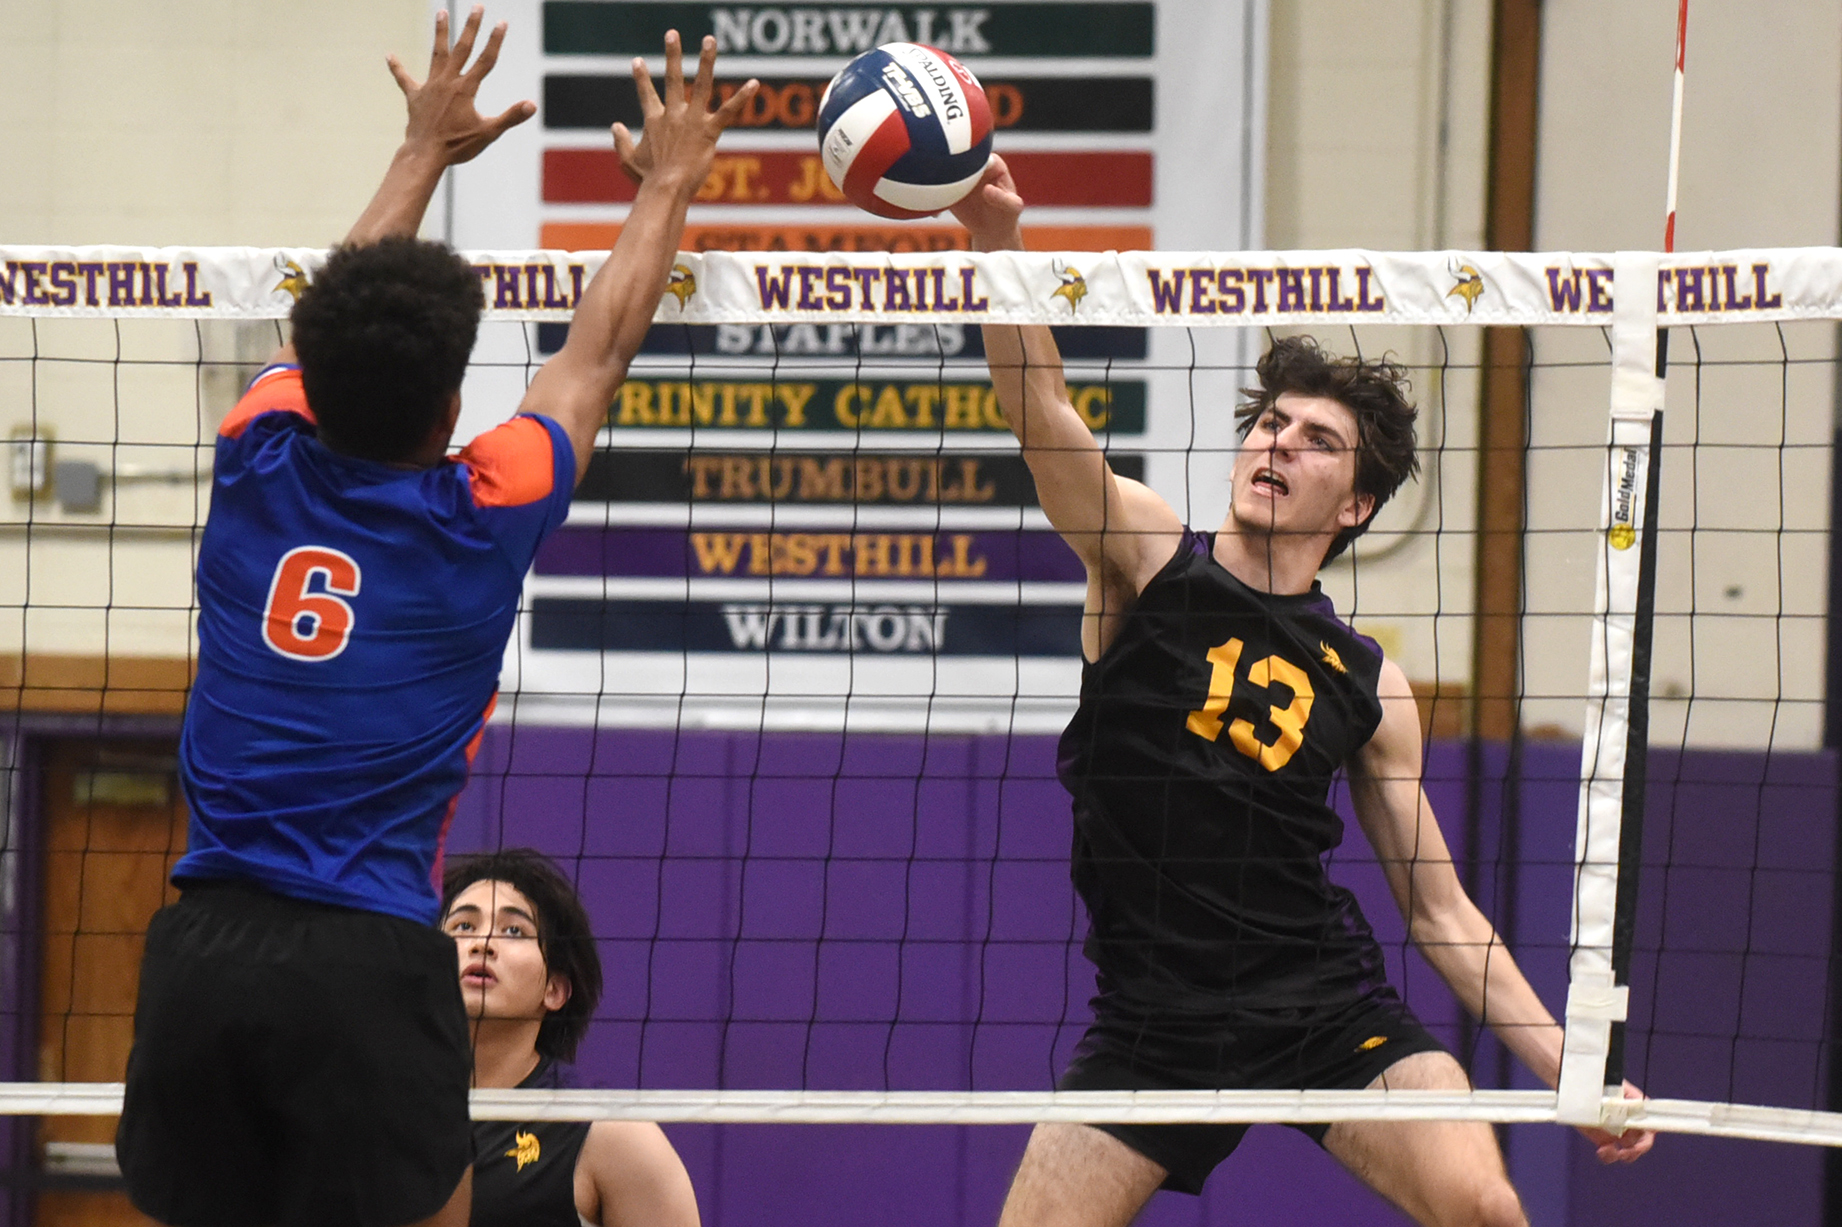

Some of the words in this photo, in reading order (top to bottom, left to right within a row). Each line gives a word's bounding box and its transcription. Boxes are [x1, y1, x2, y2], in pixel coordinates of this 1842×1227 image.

[711, 9, 992, 52] NORWALK
[755, 264, 990, 313] WESTHILL
[1146, 266, 1385, 315] WESTHILL
[715, 323, 966, 355] STAPLES
[603, 381, 816, 427] RINITY
[683, 455, 996, 500] TRUMBULL
[691, 532, 987, 577] WESTHILL
[261, 545, 362, 662] 6
[722, 604, 949, 651] WILTON
[1185, 637, 1315, 772] 13
